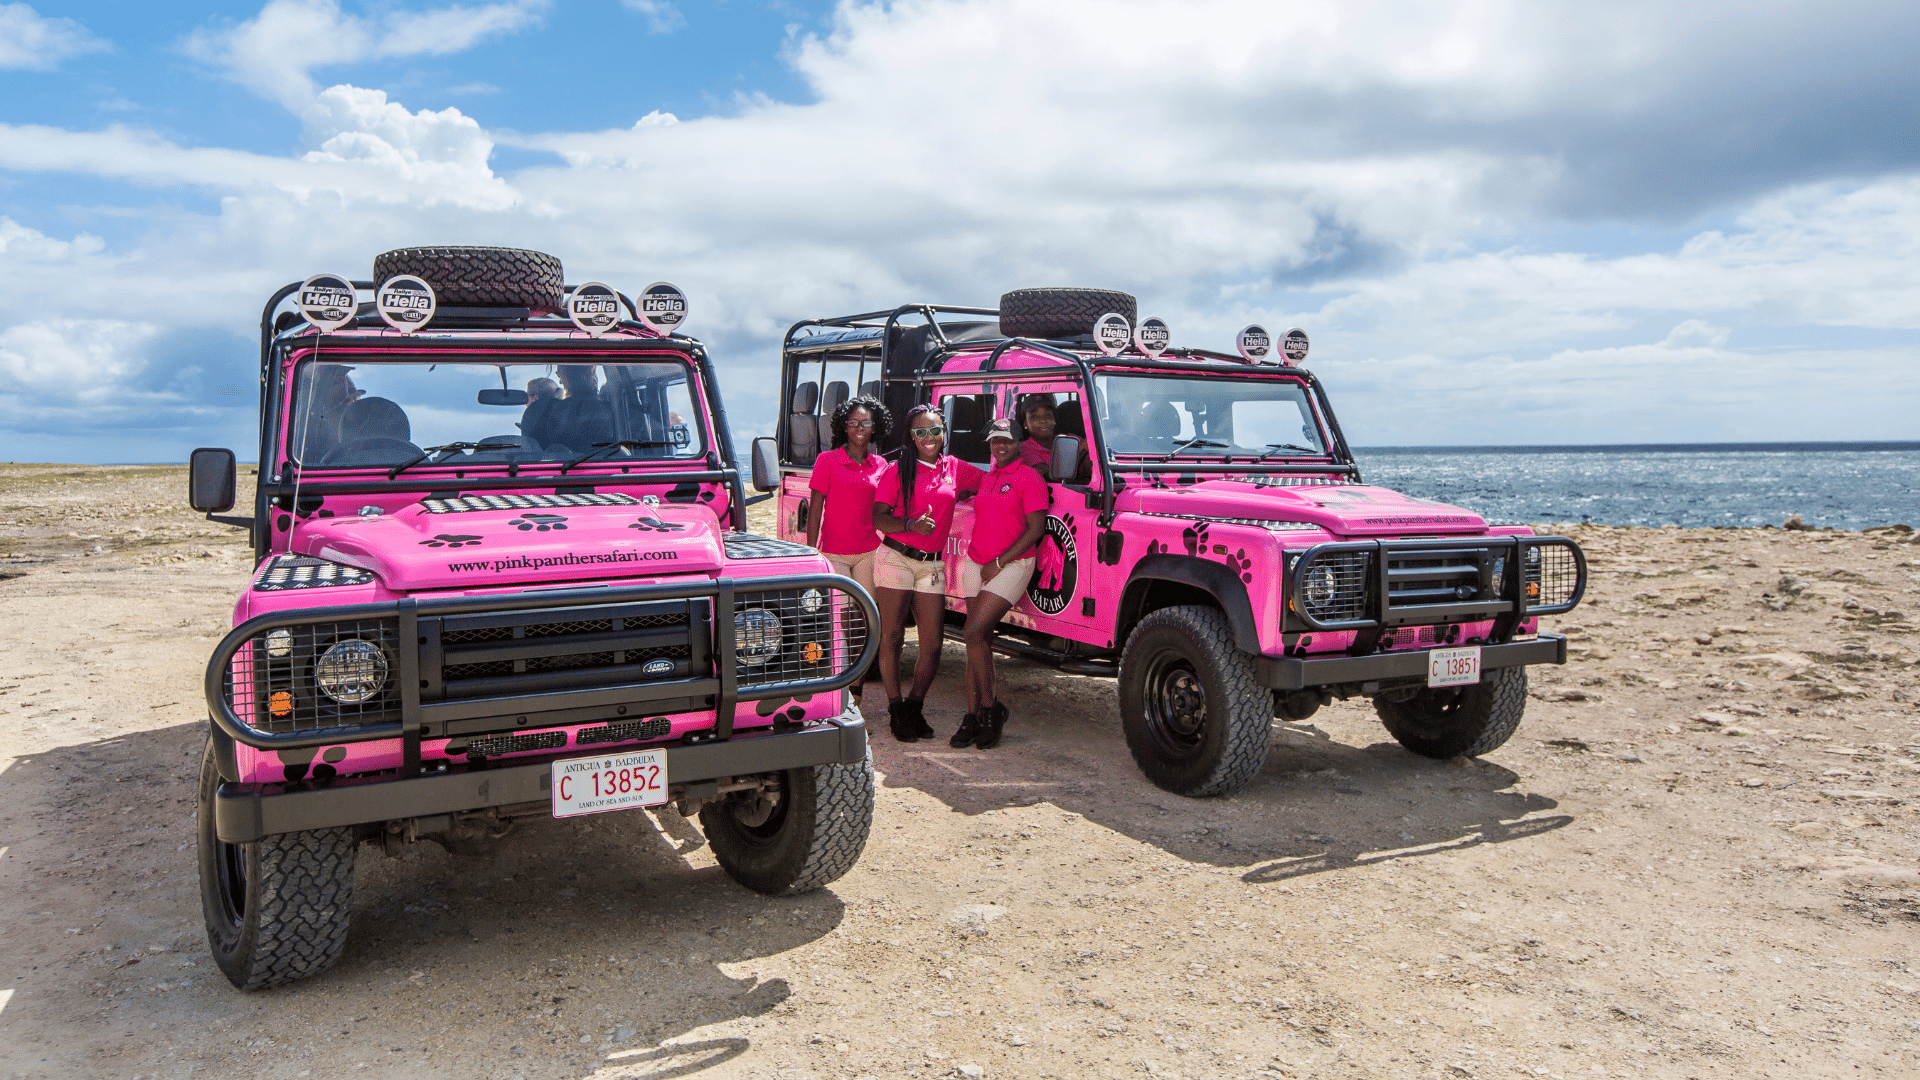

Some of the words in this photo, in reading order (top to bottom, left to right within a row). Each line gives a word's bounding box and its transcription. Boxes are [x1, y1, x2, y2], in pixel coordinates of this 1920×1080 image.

[305, 293, 351, 307] Hella
[386, 295, 429, 309] Hella
[576, 301, 616, 312] Hella
[646, 300, 683, 311] Hella
[1102, 328, 1128, 338] Hella
[1143, 331, 1168, 340] Hella
[1245, 337, 1268, 346] Hella
[1286, 341, 1308, 350] Hella
[946, 536, 970, 557] TIG
[1045, 518, 1076, 561] ANTHER
[448, 549, 678, 573] www.pinkpanthersafari.com
[1033, 589, 1065, 612] SAFARI
[1432, 660, 1439, 677] C
[1447, 657, 1477, 676] 13851
[564, 761, 601, 774] ANTIGUA
[615, 755, 656, 767] BARBUDA
[560, 775, 573, 801] C
[592, 765, 661, 797] 13852
[579, 801, 595, 809] LAND
[618, 796, 630, 804] AND
